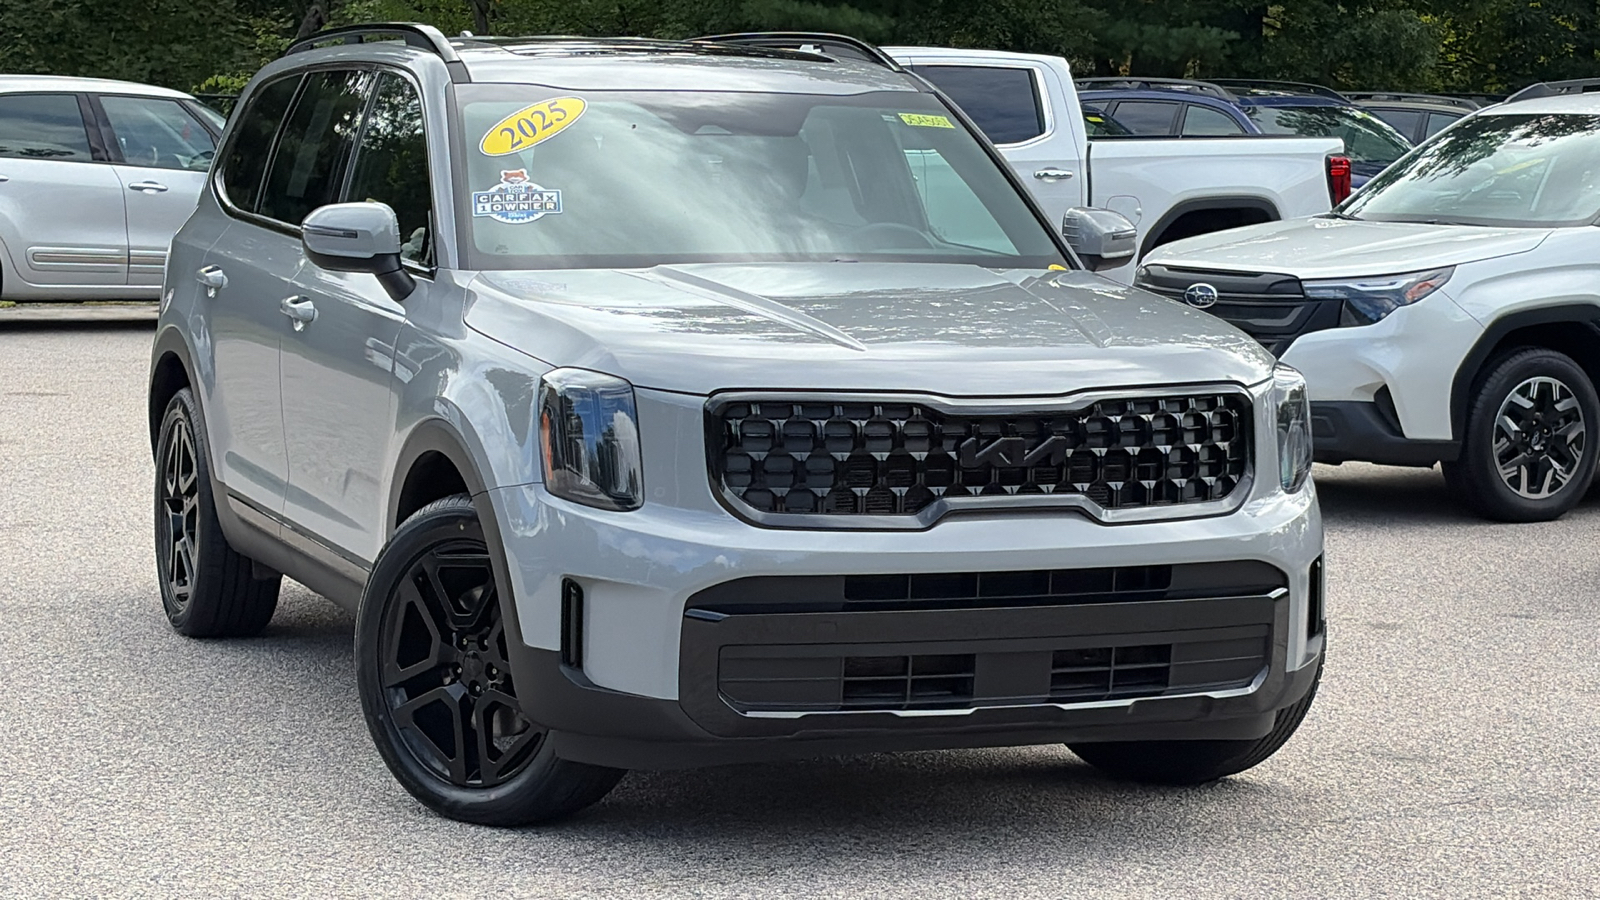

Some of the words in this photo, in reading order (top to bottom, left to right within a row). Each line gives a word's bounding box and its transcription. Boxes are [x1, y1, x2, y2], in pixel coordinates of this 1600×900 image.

[500, 101, 567, 149] 2025
[479, 193, 555, 203] CARFAX
[492, 202, 556, 211] OWNER
[960, 437, 1067, 467] KIA
